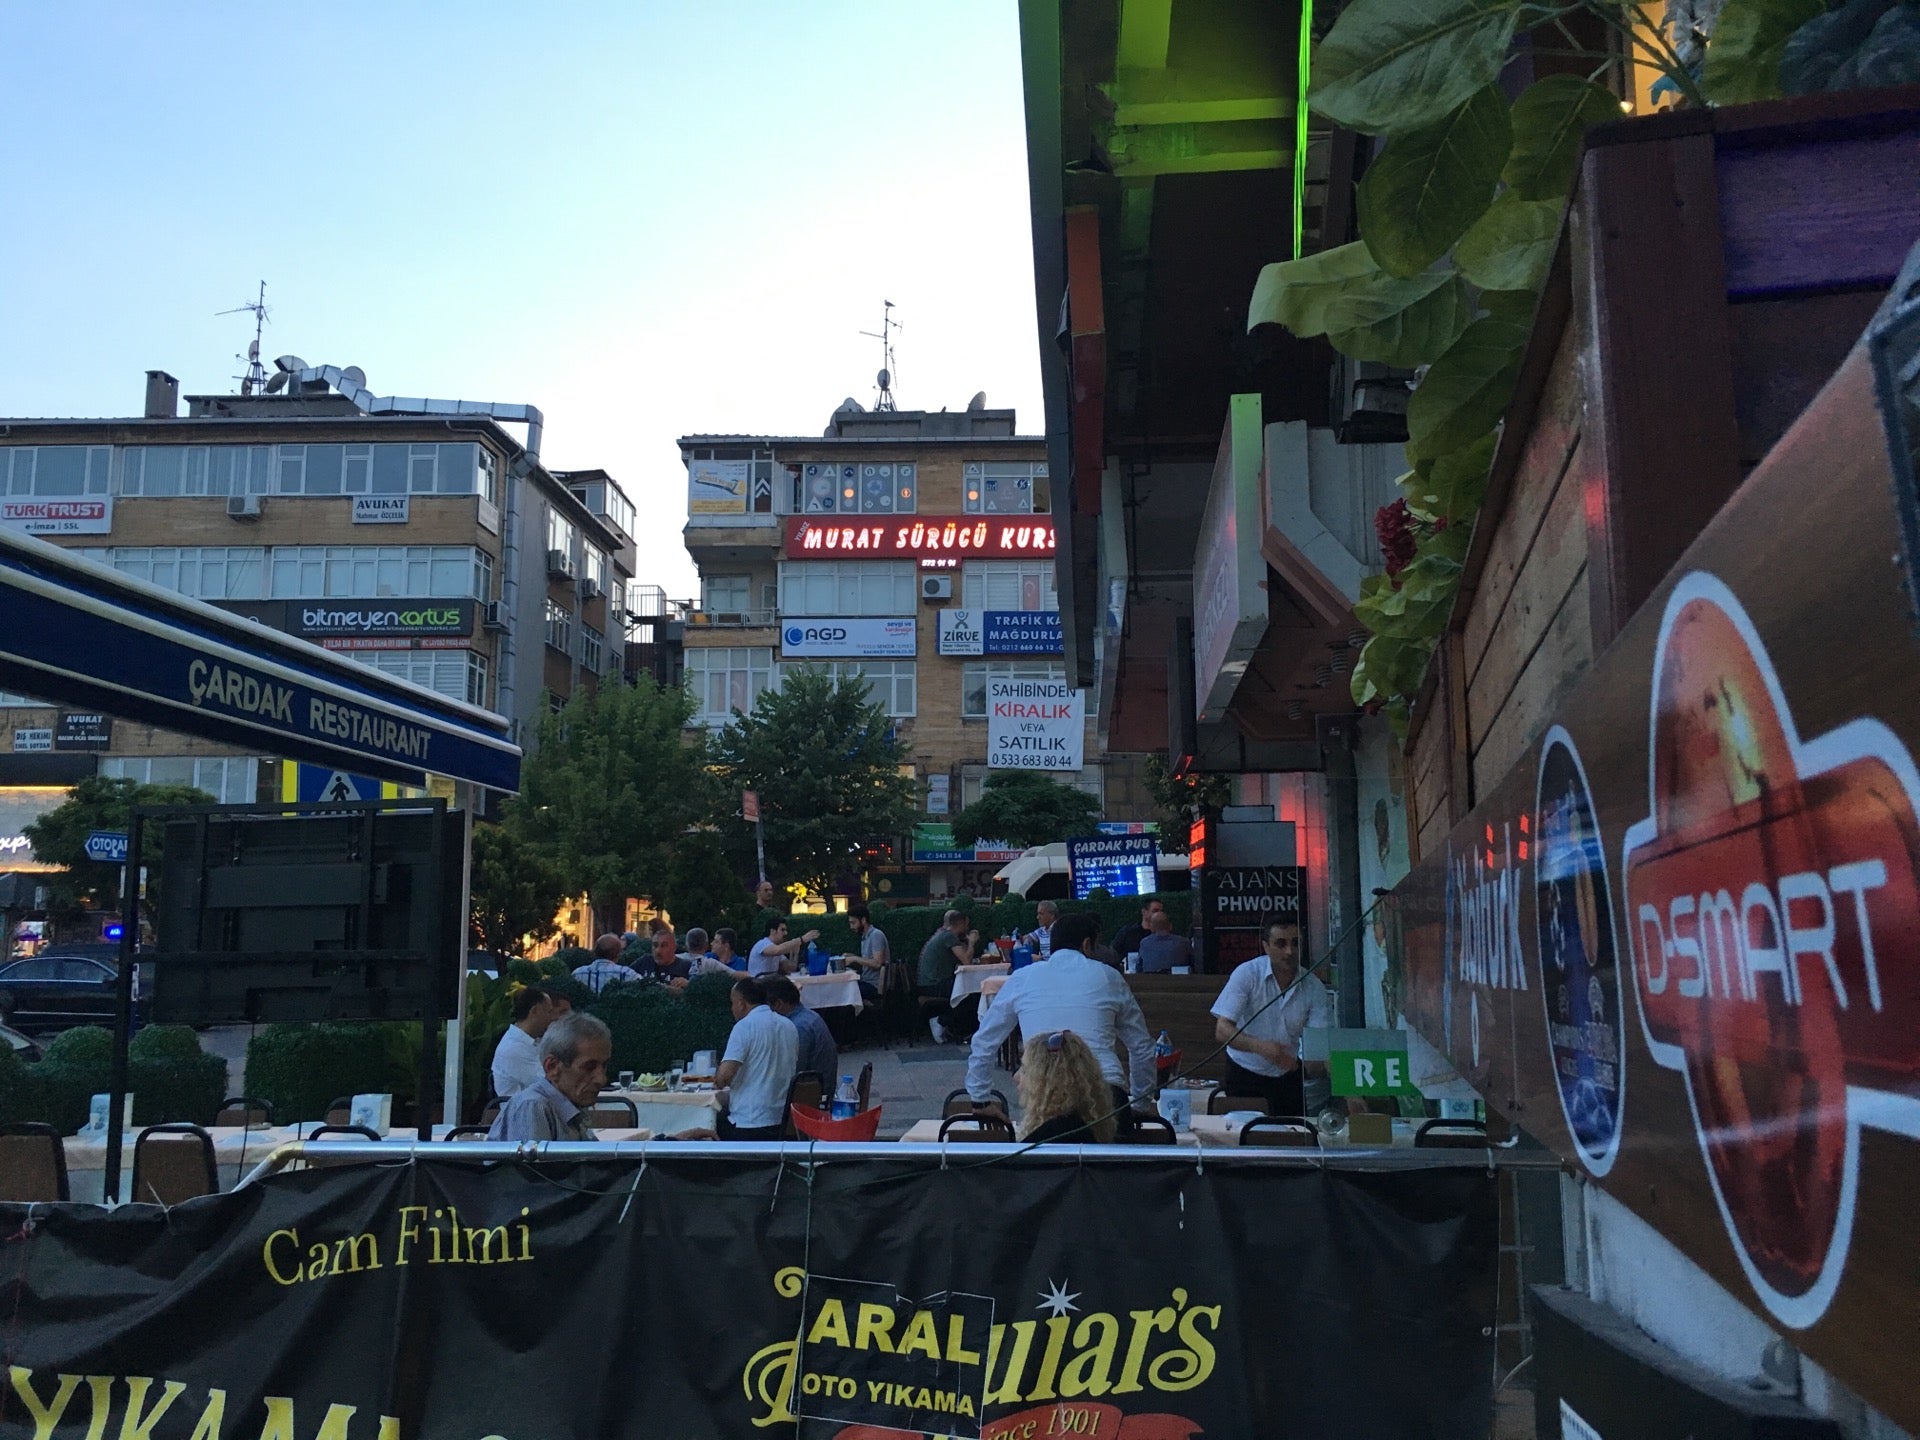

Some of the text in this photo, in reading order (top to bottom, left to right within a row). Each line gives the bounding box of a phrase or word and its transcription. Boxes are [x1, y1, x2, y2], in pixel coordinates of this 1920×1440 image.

[356, 499, 405, 510] AVUKAT
[803, 527, 885, 550] MURAT
[896, 522, 987, 549] SÜRÜCÜ
[995, 613, 1041, 625] TRAFİK
[805, 627, 847, 640] AGD
[943, 629, 979, 642] ZİRVE
[991, 682, 1076, 698] SAHİBİNDEN
[188, 658, 432, 760] ÇARDAK RESTAURANT
[994, 701, 1072, 719] KİRALIK
[65, 715, 103, 723] AVUKAT
[1020, 723, 1045, 733] VEYA
[999, 735, 1066, 751] SATILIK
[992, 753, 1072, 767] 0 533 683 80 44
[1073, 838, 1151, 856] ÇARDAK PUB
[1074, 853, 1152, 869] RESTAURANT
[1219, 871, 1299, 893] AJANS
[1217, 896, 1299, 912] PHWORK
[263, 1204, 535, 1286] Cam Filmi
[806, 1297, 981, 1367] ARAL
[801, 1372, 976, 1418] OTO YIKAMA
[1046, 1407, 1103, 1436] 1901
